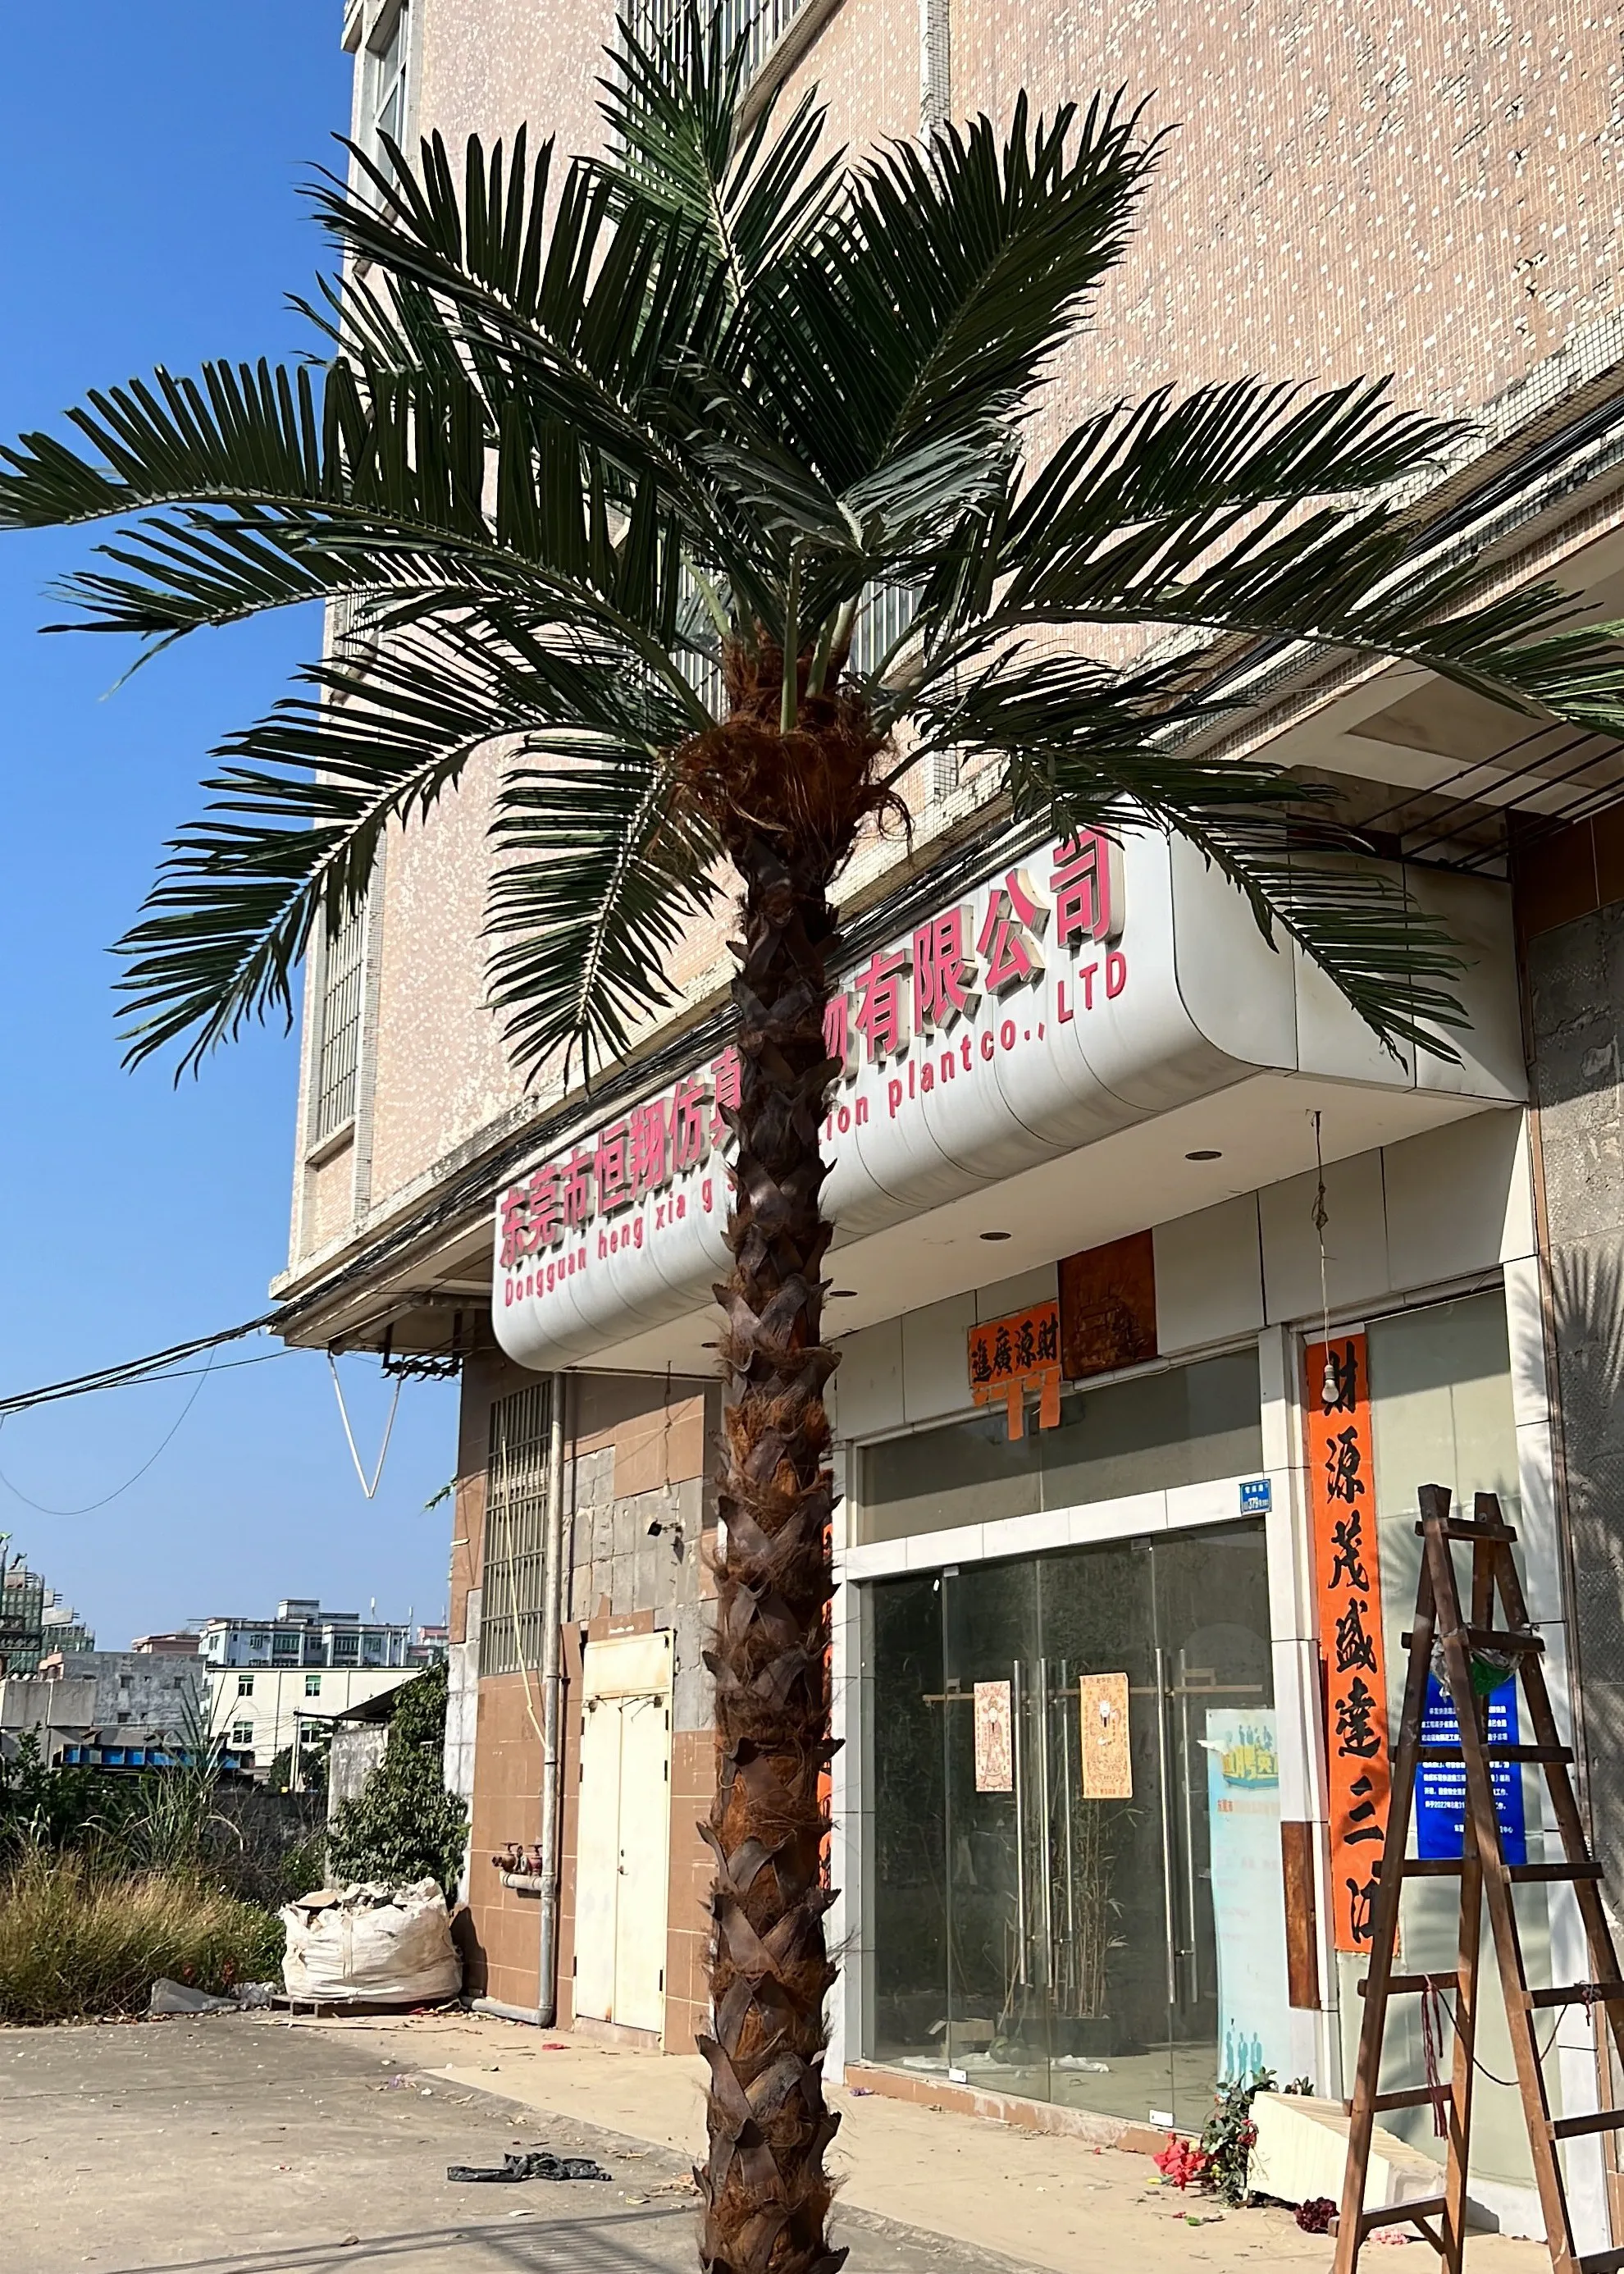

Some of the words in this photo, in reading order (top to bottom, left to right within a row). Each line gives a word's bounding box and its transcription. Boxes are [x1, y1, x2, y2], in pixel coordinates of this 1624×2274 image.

[500, 824, 1114, 1267] 东莞市恒翔仿真物有限公司
[505, 1248, 587, 1306] Dongguan
[598, 1217, 644, 1259] heng
[1058, 952, 1127, 1024] LTD
